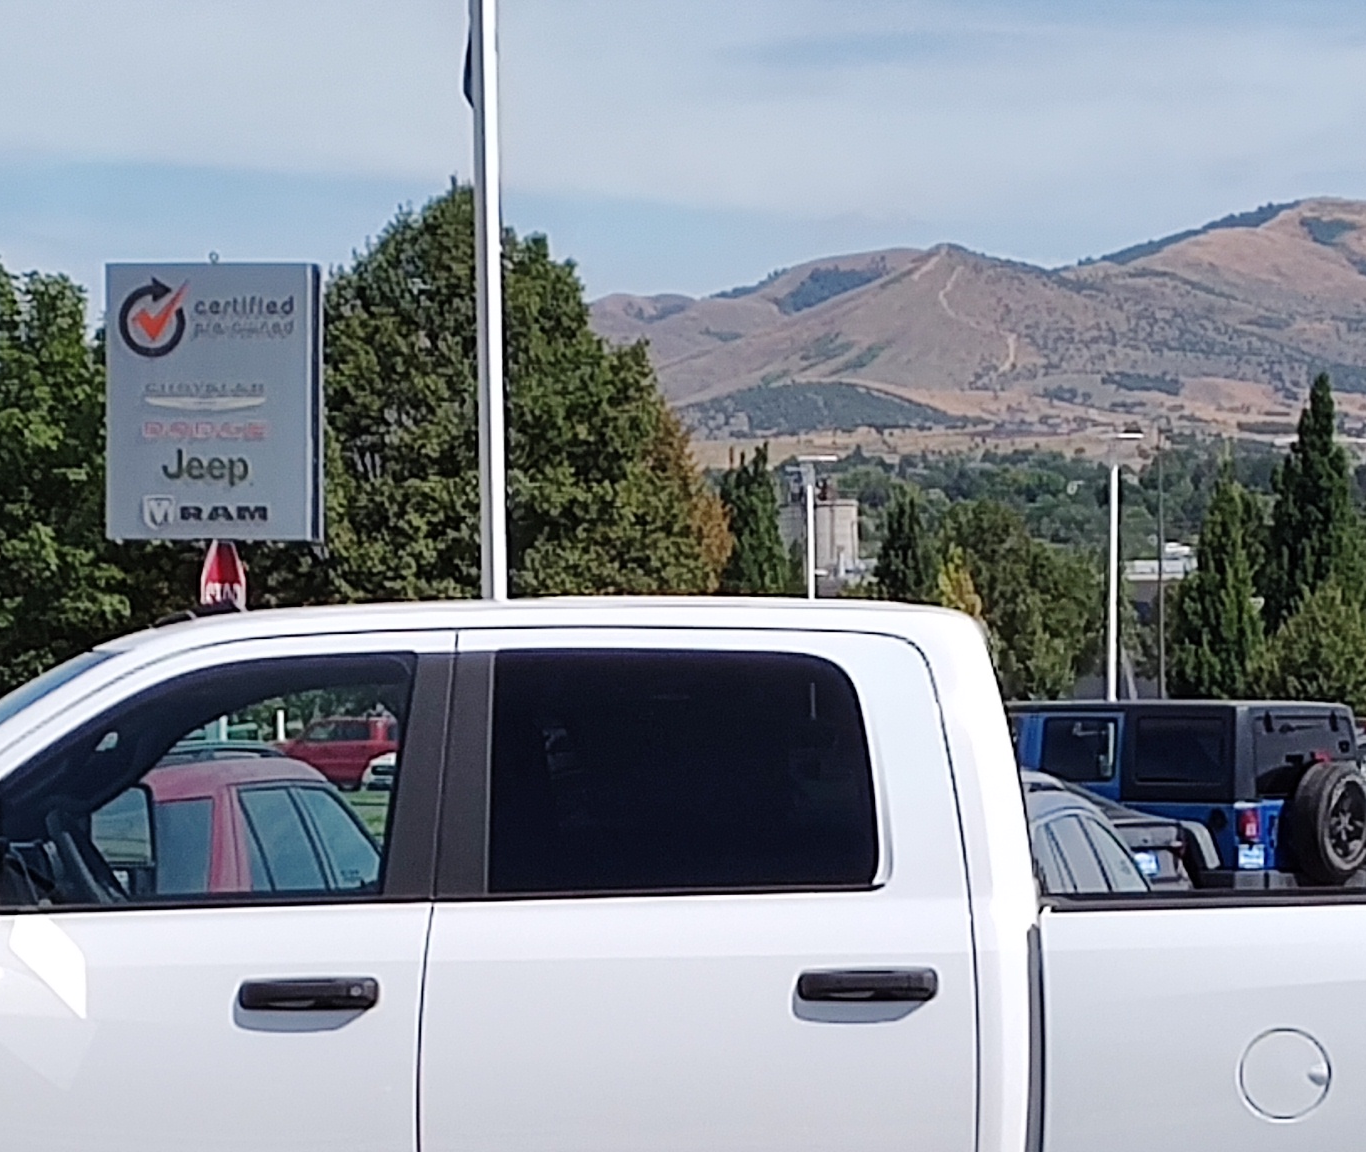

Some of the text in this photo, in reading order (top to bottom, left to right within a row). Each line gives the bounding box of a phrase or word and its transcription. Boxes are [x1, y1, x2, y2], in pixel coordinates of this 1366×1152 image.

[195, 295, 294, 315] certified
[142, 421, 269, 440] DODGE
[162, 448, 249, 487] Jeep
[180, 505, 268, 522] RAM
